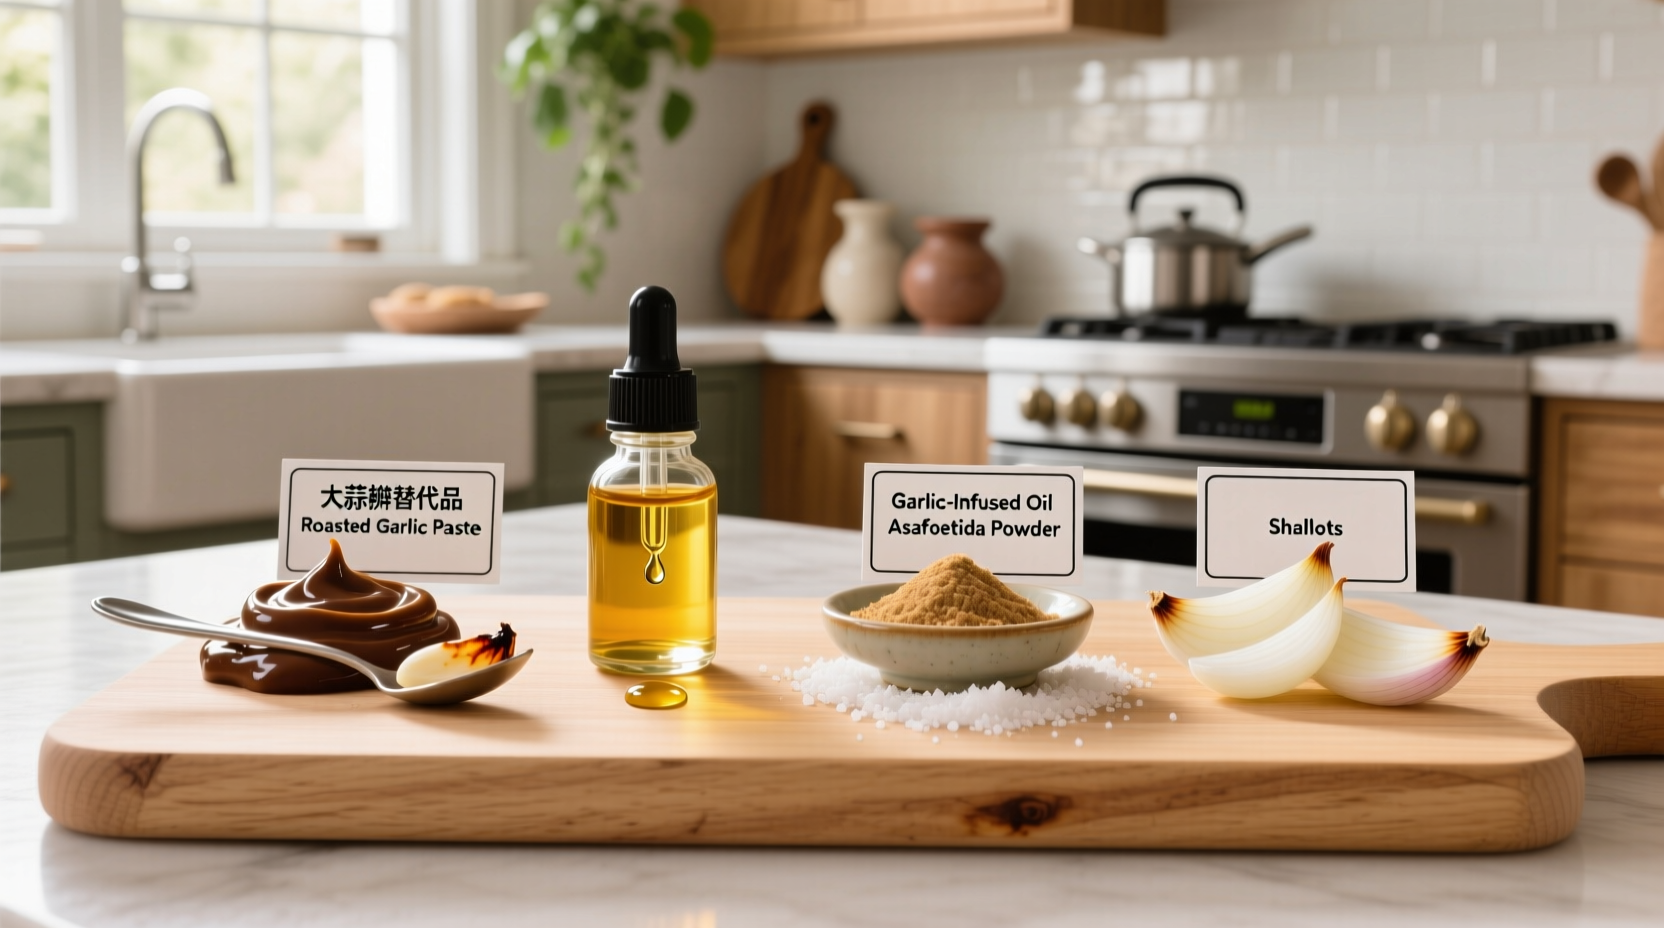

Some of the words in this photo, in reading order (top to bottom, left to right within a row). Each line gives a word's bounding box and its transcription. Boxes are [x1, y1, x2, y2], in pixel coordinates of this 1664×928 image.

[892, 492, 1020, 510] Garlic-Infused
[1027, 494, 1052, 511] Oil
[301, 517, 370, 533] Roasted
[376, 518, 427, 535] Garlic
[433, 519, 481, 536] Paste
[888, 518, 985, 536] Asafoetida
[992, 520, 1060, 537] Powder
[1269, 518, 1343, 536] Shallots
